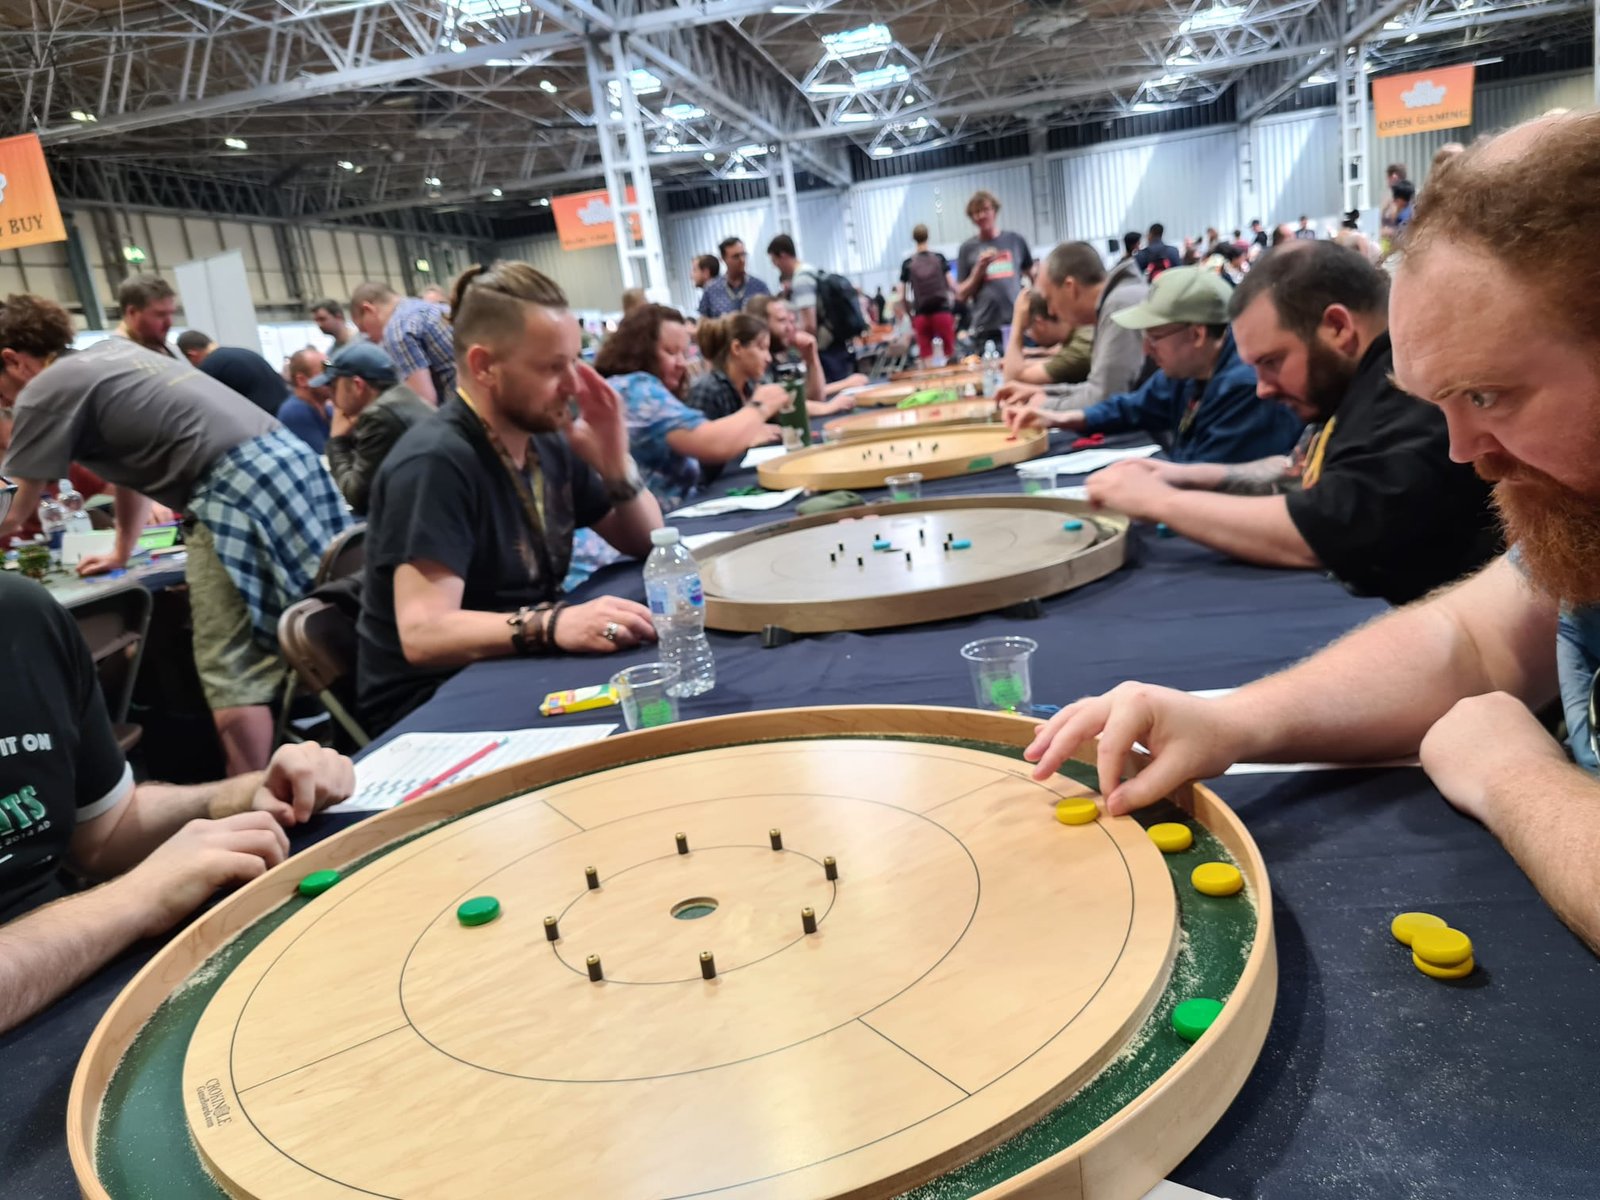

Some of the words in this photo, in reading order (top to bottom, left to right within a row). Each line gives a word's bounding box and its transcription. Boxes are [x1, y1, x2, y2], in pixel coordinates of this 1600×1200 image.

[1379, 117, 1412, 131] OPEN
[1416, 108, 1469, 126] GAMING
[9, 215, 43, 235] BUY
[21, 733, 52, 752] ON
